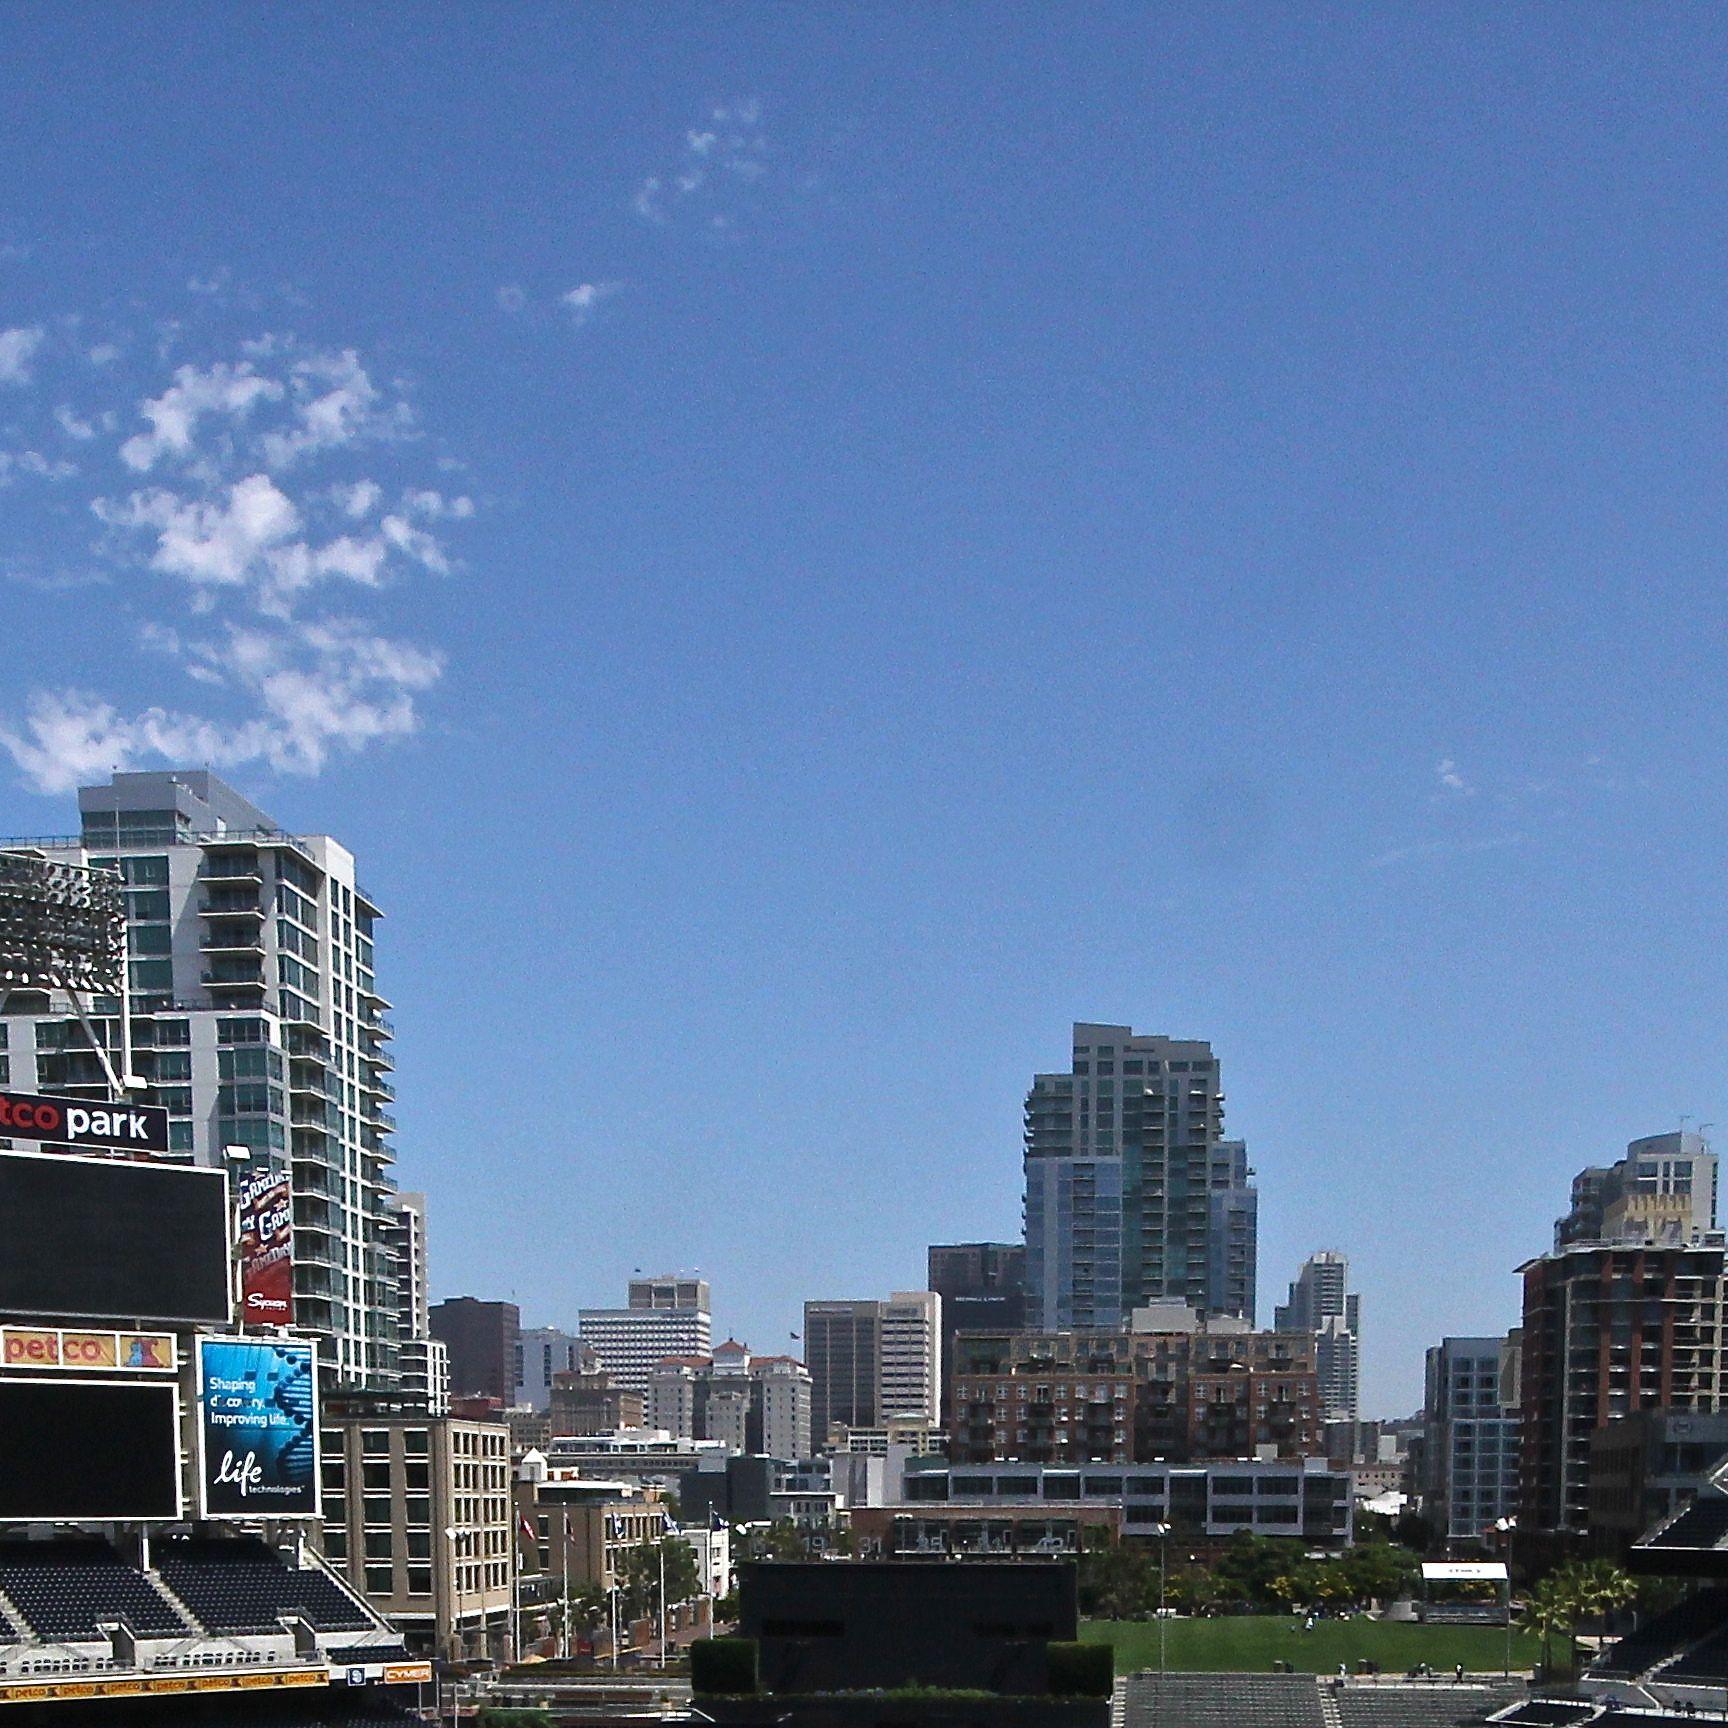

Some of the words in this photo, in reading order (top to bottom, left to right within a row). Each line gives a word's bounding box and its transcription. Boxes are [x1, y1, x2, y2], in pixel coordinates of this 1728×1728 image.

[66, 1107, 149, 1140] park
[210, 1376, 257, 1392] Shaping
[211, 1412, 268, 1428] Improving
[213, 1450, 263, 1497] life
[14, 1687, 46, 1698] petco
[63, 1684, 94, 1696] petco
